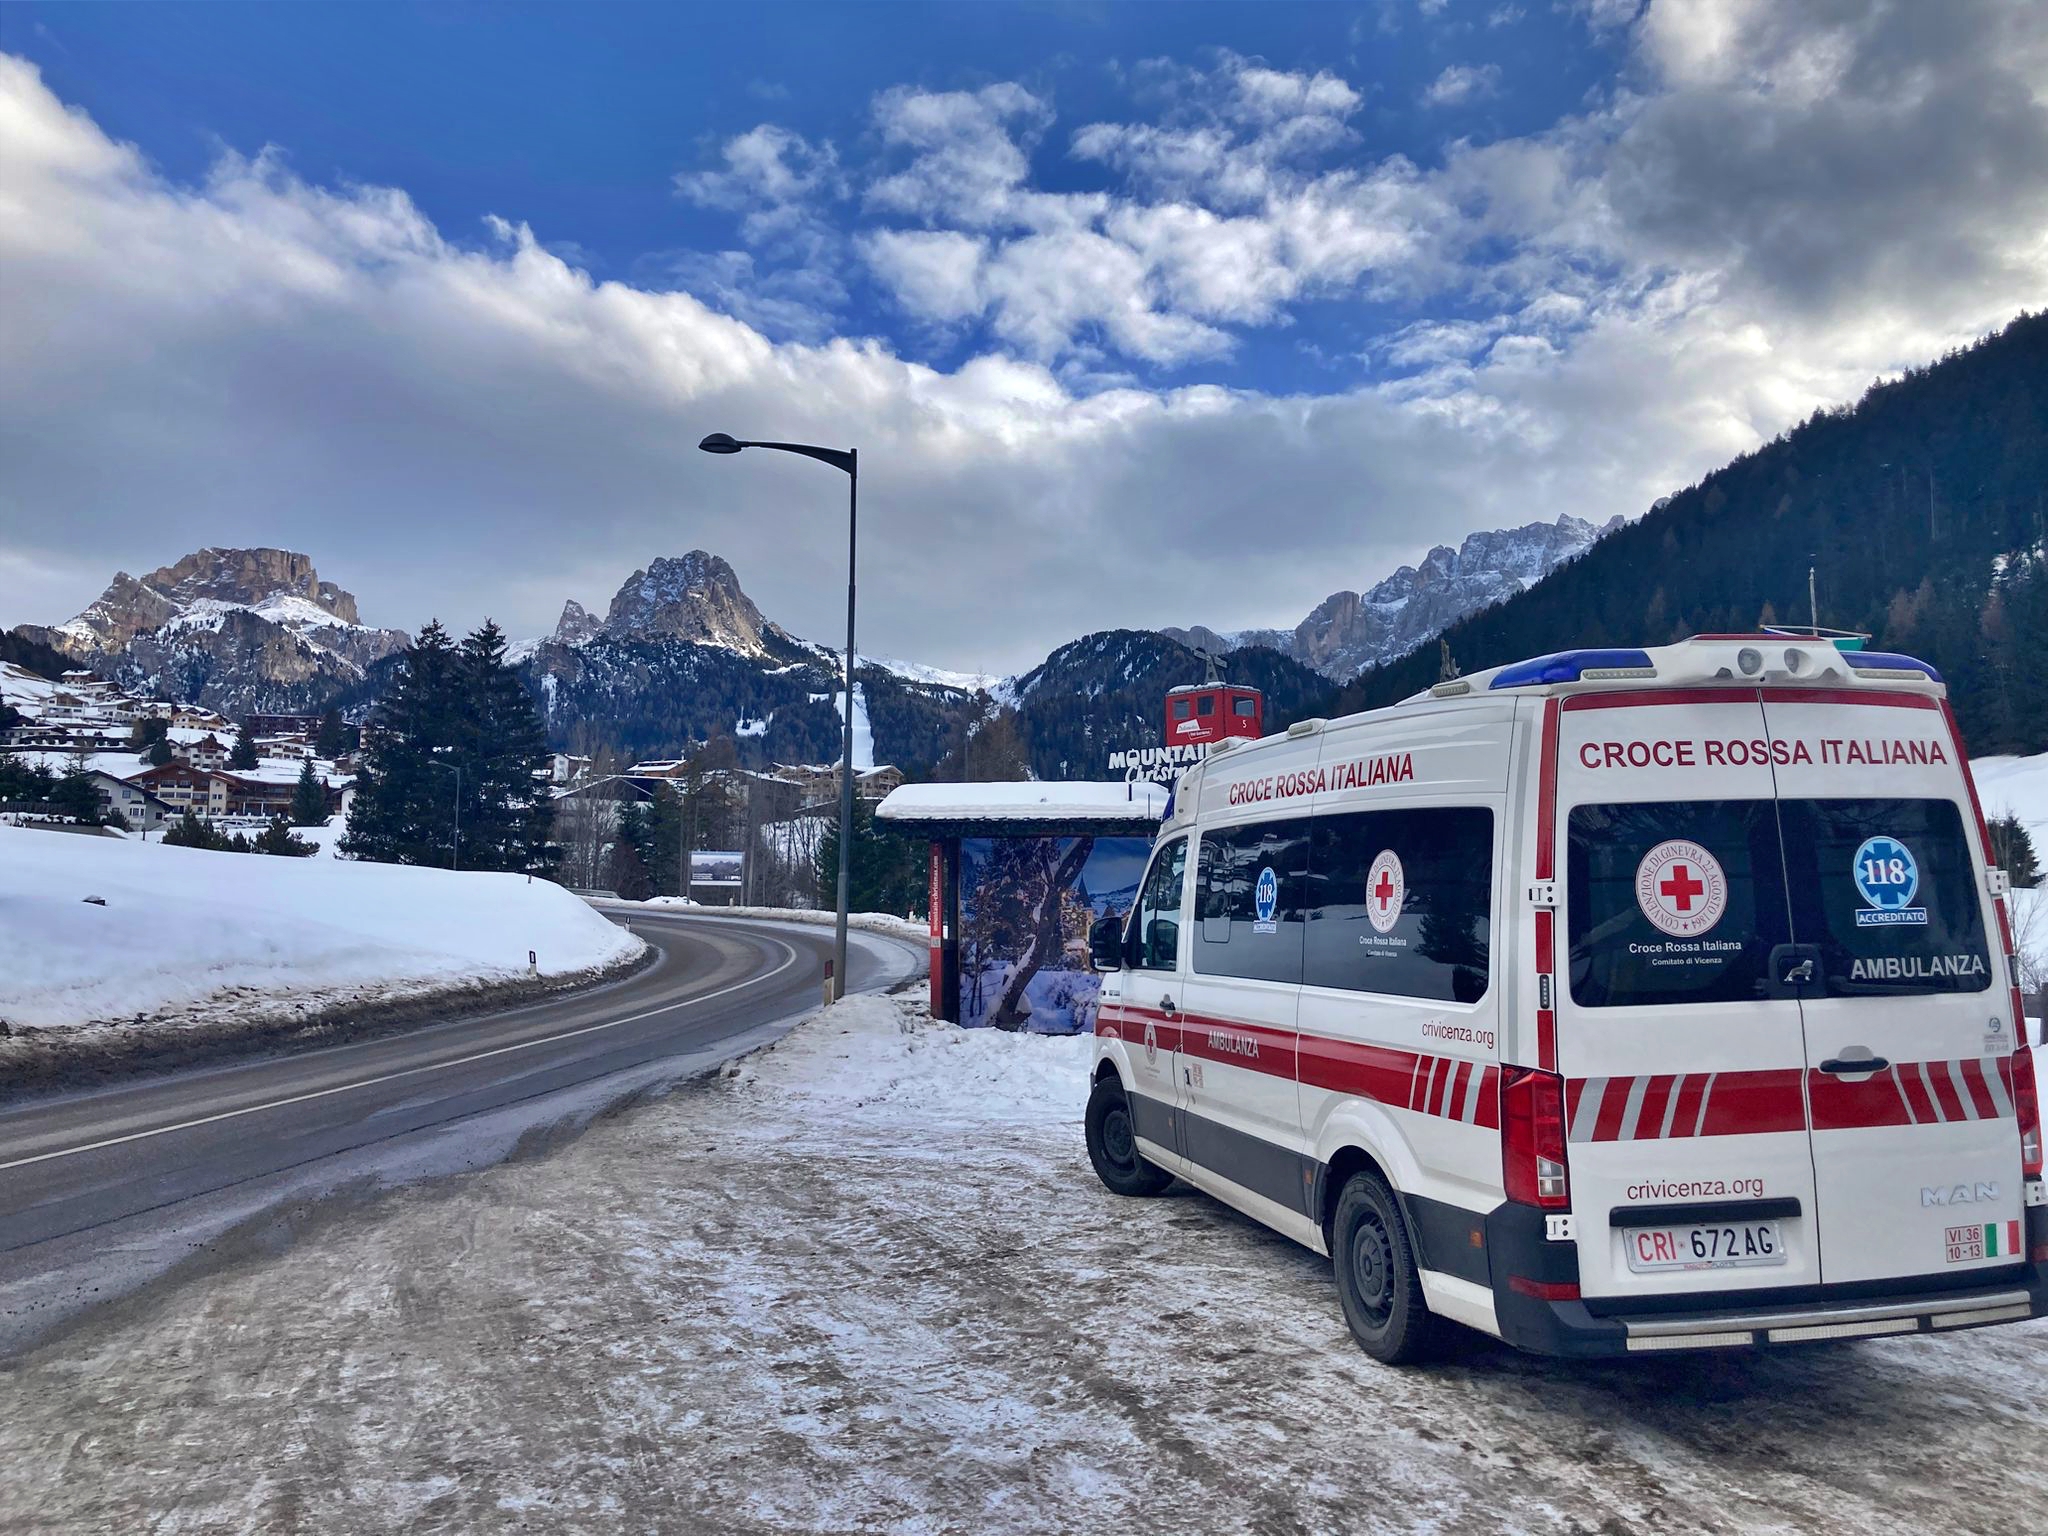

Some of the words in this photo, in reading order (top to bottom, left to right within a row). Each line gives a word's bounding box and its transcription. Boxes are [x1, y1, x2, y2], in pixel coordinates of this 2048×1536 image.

[1579, 740, 1696, 769] CROCE
[1704, 739, 1814, 766] ROSSA
[1820, 739, 1949, 766] ITALIANA
[1125, 758, 1189, 785] Christm
[1229, 777, 1274, 806] CROCE
[1275, 768, 1327, 799] ROSSA
[1330, 752, 1414, 791] ITALIANA
[1649, 854, 1663, 868] DI
[1661, 845, 1703, 864] GINEVRA
[1702, 859, 1713, 873] 22
[1864, 858, 1906, 885] 118
[1259, 883, 1273, 903] 118
[1641, 865, 1679, 929] CONVENZIONE
[1708, 872, 1722, 915] AGOSTO
[1858, 911, 1926, 923] ACCREDITATO
[1629, 942, 1663, 953] Croce
[1665, 941, 1700, 952] Rossa
[1702, 940, 1742, 951] Italiana
[1652, 958, 1685, 966] Comitato
[1686, 957, 1693, 965] di
[1694, 957, 1723, 965] Vicenza
[1851, 954, 1986, 980] AMBULANZA
[1207, 1030, 1260, 1058] AMBULANZA
[1421, 1020, 1494, 1050] crivicenza.org
[1627, 1178, 1764, 1200] crivicenza.org
[1921, 1181, 2000, 1208] MAN
[1637, 1231, 1677, 1262] CRI
[1949, 1230, 1961, 1242] VI
[1966, 1228, 1980, 1241] 36
